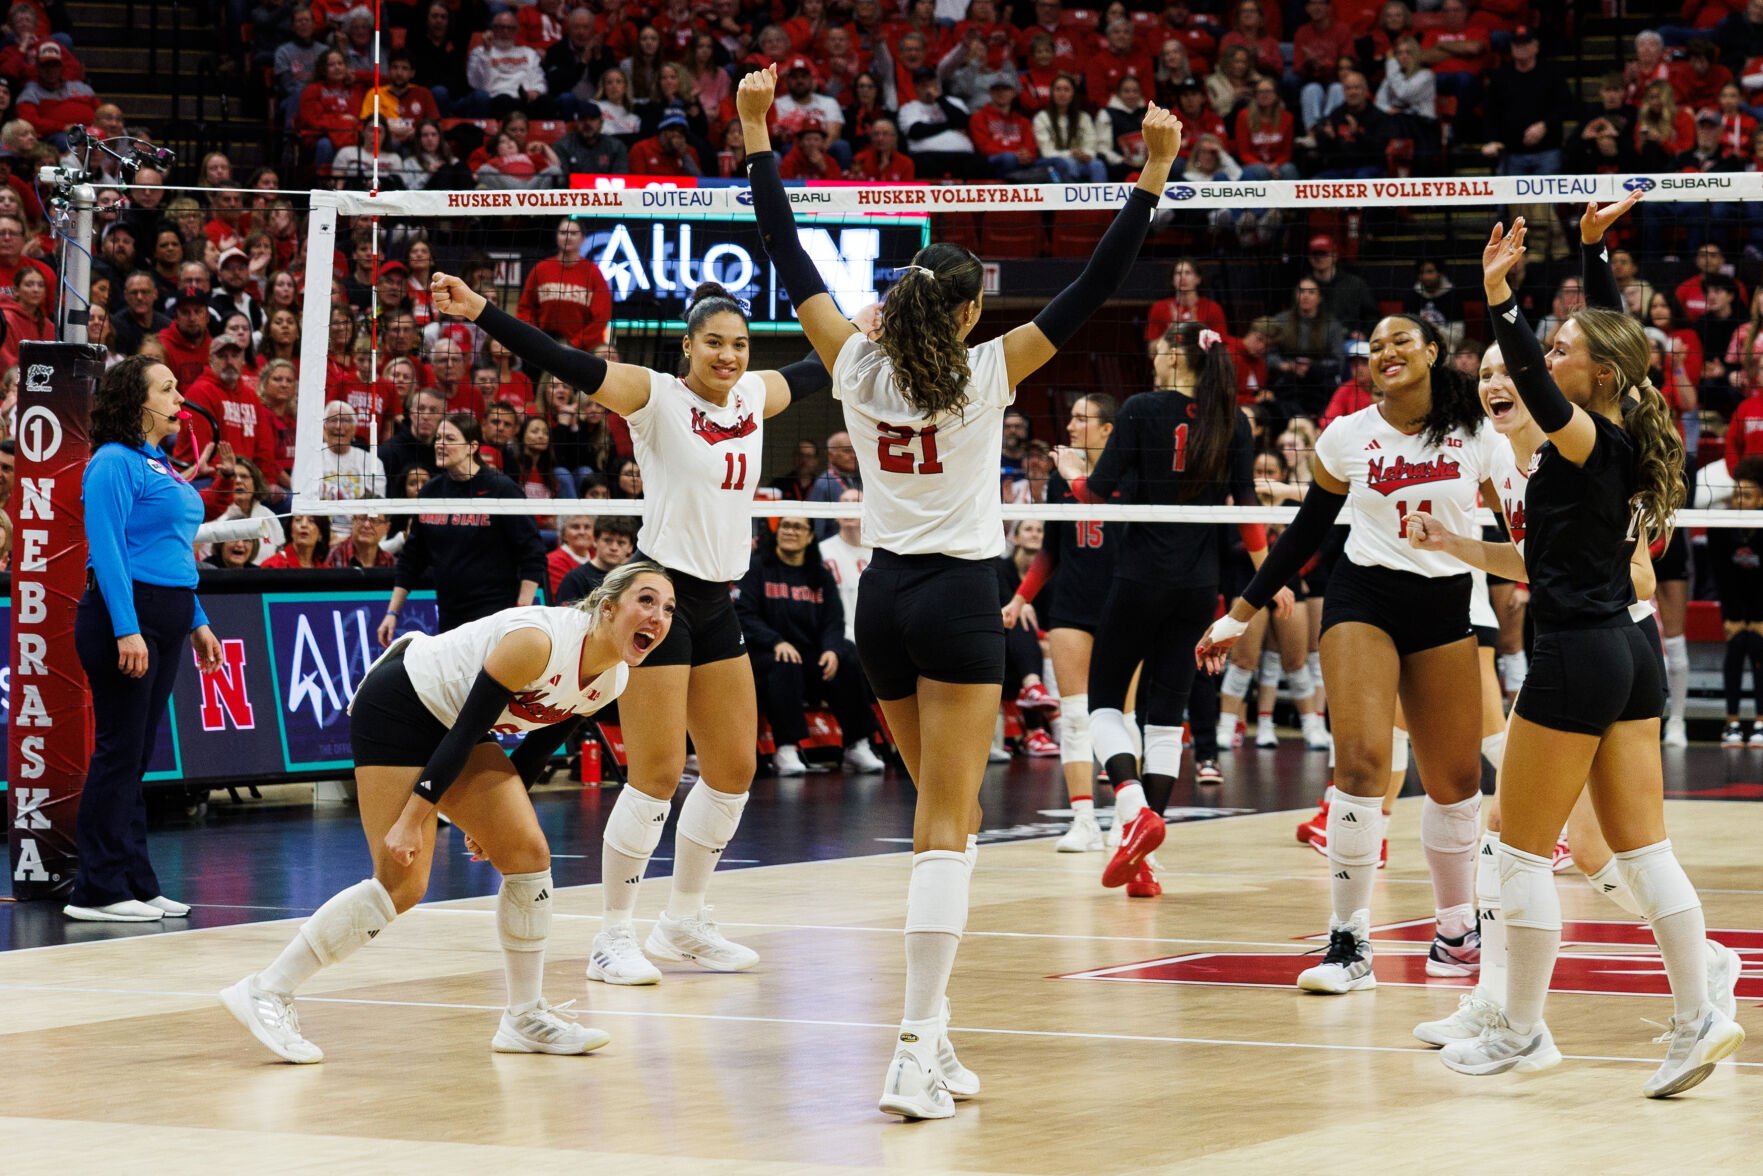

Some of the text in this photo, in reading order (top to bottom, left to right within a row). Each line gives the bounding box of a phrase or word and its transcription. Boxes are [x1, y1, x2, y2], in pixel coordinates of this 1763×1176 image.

[448, 193, 512, 208] HUSKER
[516, 192, 623, 207] VOLLEYBALL
[642, 191, 713, 207] DUTEAU
[788, 192, 831, 203] BARU
[858, 189, 927, 205] HUSKER
[930, 187, 1044, 204] VOLLEYBALL
[1200, 187, 1266, 198] SUBARU
[1295, 183, 1368, 199] HUSKER
[1372, 180, 1494, 197] VOLLEYBALL
[1516, 178, 1597, 196] DUTEAU
[1660, 177, 1731, 189] SUBARU
[599, 223, 753, 300] Allo
[721, 452, 747, 490] 11
[877, 421, 944, 475] 21
[1172, 422, 1188, 472] 1
[1367, 454, 1461, 484] Nebraska
[1075, 520, 1104, 548] 15
[14, 477, 55, 881] NEBRASKA
[193, 638, 255, 732] N
